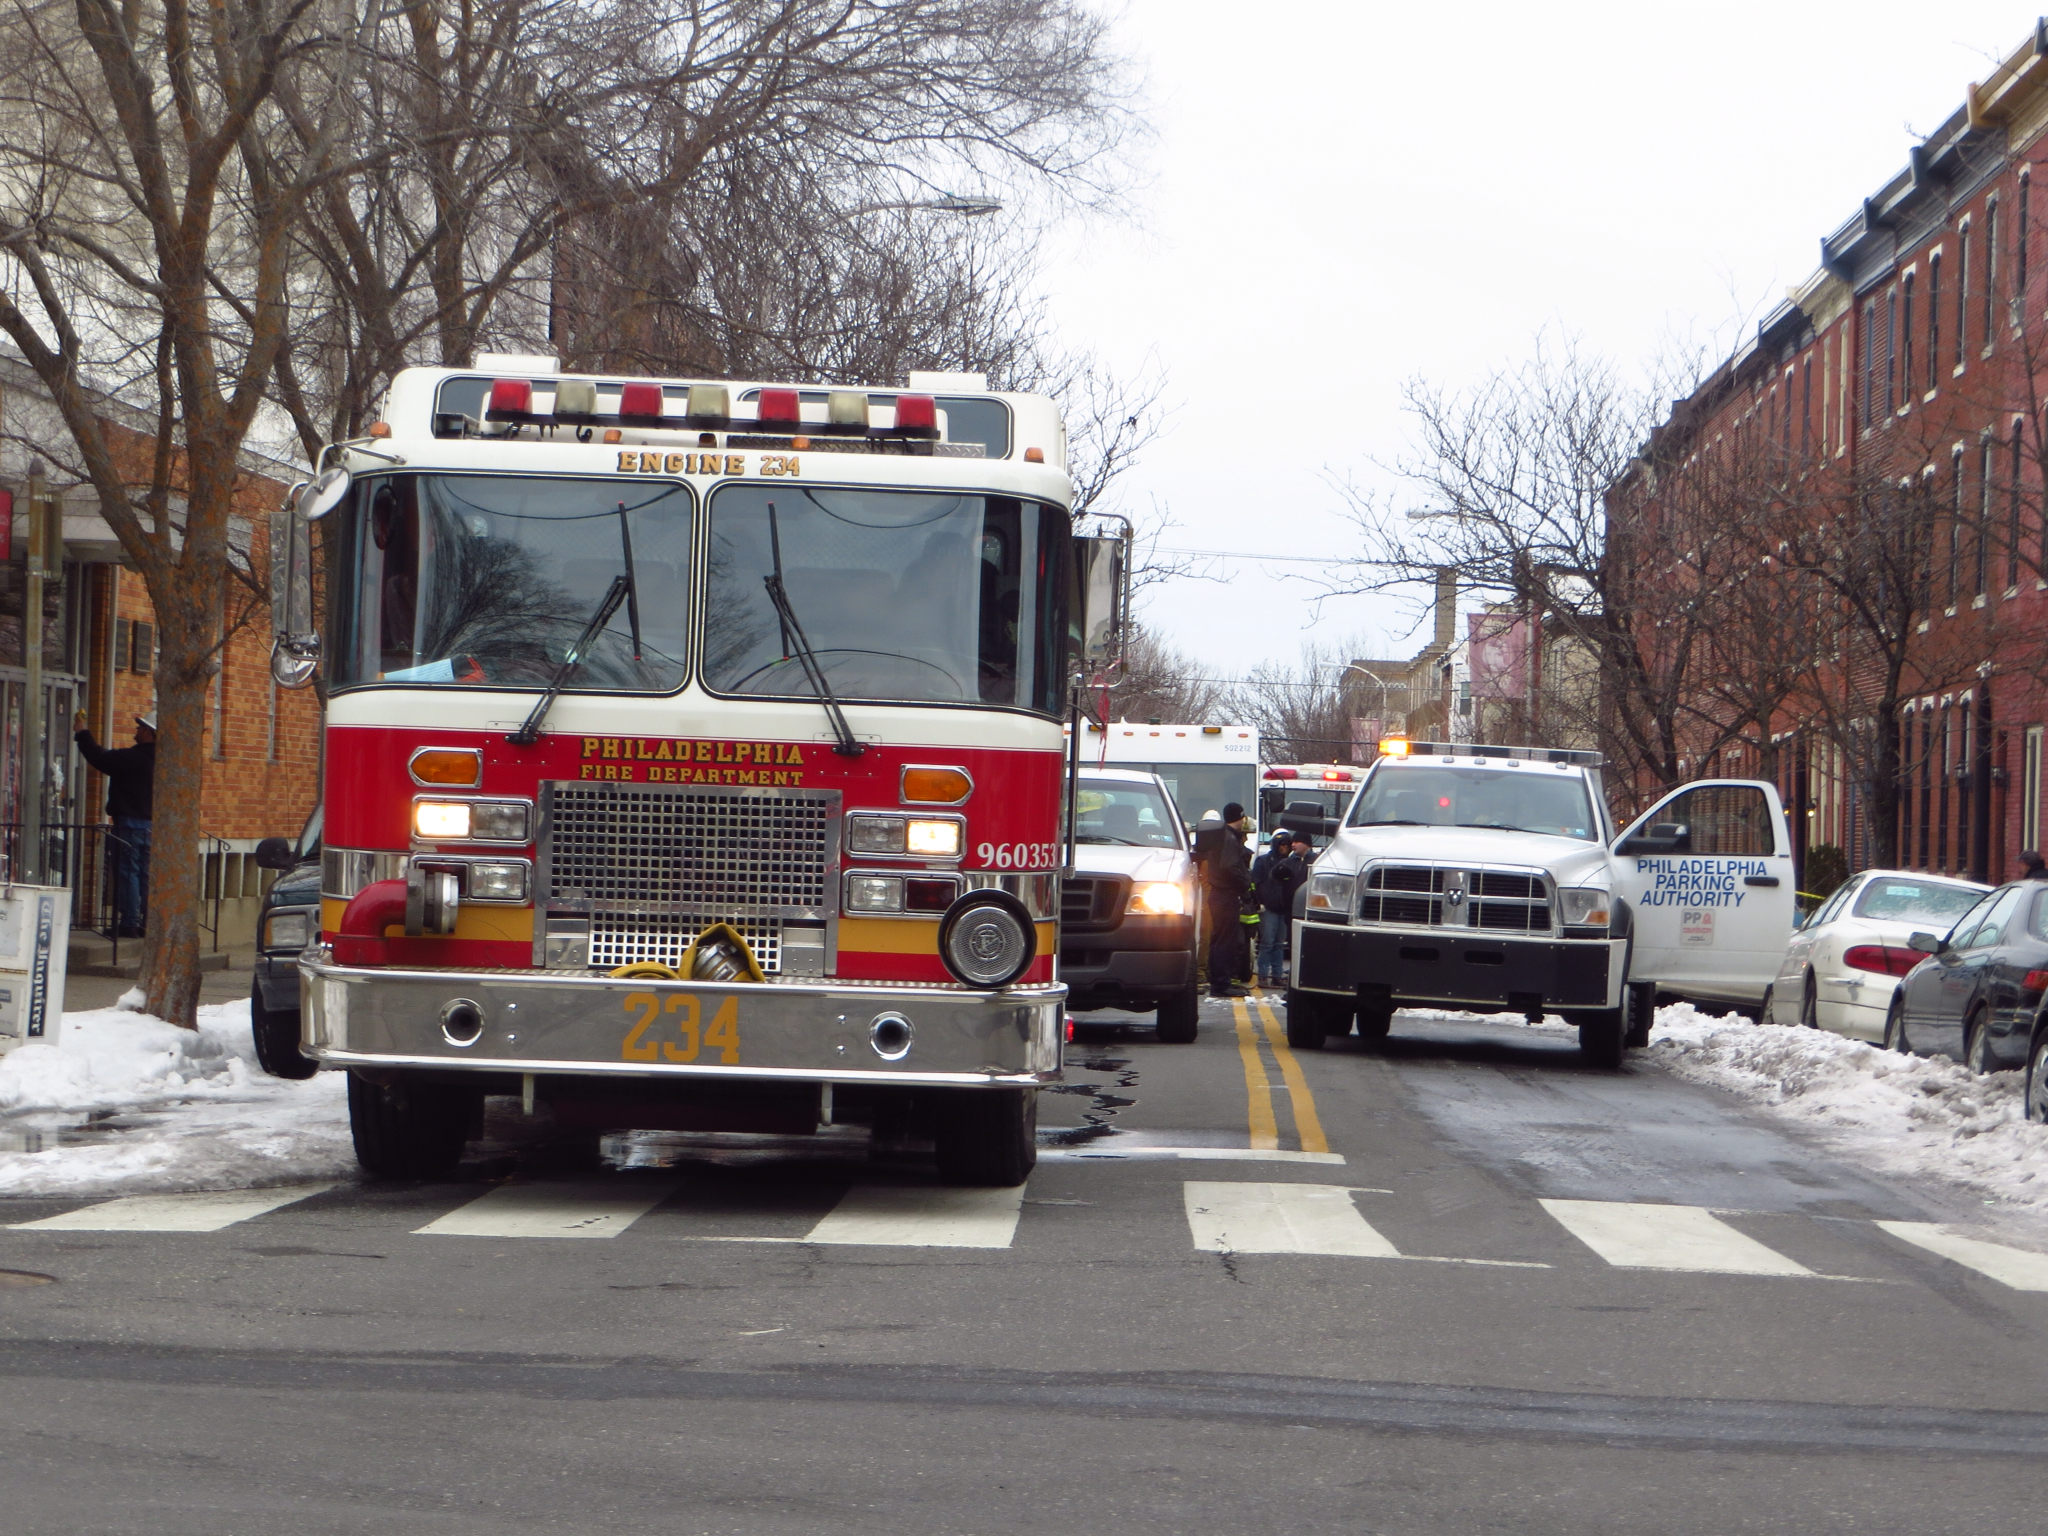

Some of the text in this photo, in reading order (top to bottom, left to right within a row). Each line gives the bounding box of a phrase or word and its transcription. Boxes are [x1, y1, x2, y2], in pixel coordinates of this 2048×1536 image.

[617, 451, 800, 476] ENGINE 234
[581, 737, 804, 765] PHILADELPHIA
[1224, 744, 1251, 752] 502212
[580, 764, 804, 786] FIRE DEPARTMENT
[977, 842, 1056, 868] 960353
[1637, 859, 1767, 876] PHILADELPHIA
[1655, 874, 1735, 891] PARKING
[1639, 890, 1746, 907] AUTHORITY
[31, 943, 49, 1034] Inquirer
[622, 992, 740, 1064] 234
